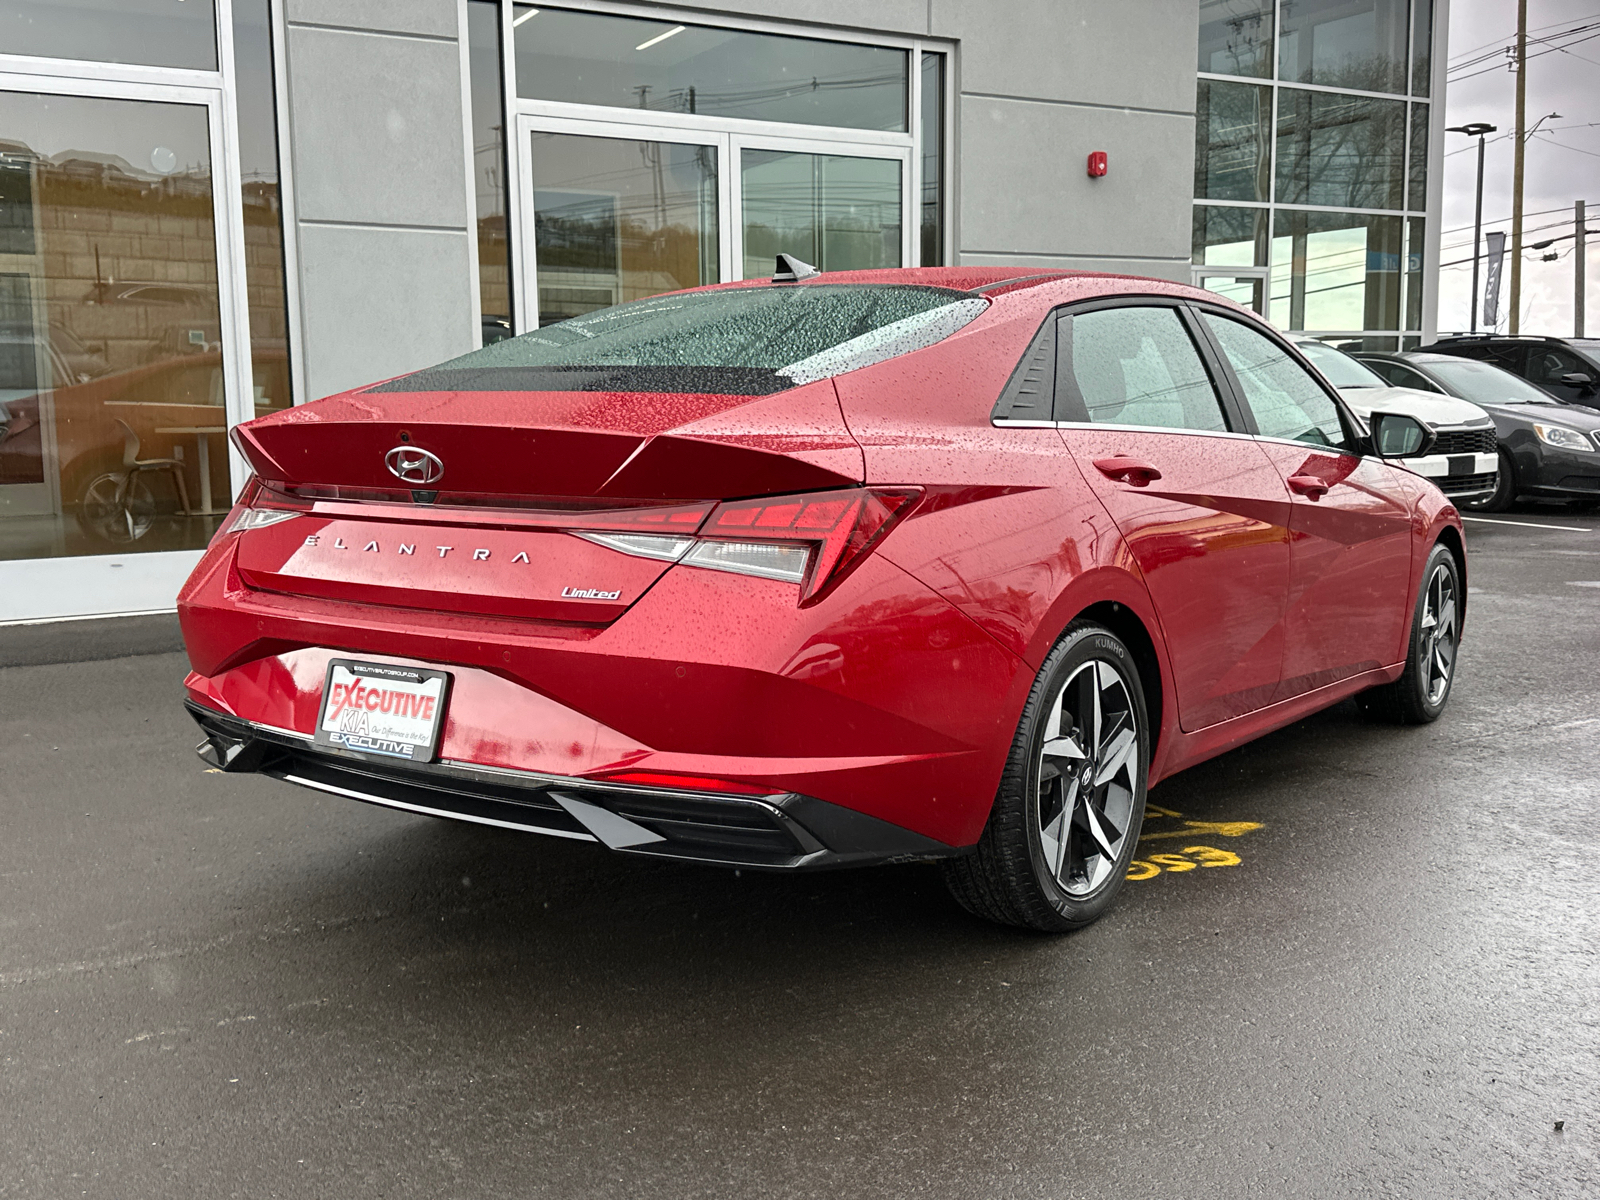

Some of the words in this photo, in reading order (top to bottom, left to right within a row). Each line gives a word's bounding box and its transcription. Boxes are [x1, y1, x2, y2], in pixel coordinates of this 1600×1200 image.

[304, 535, 531, 564] ELANTRA
[561, 586, 622, 600] Limited
[1095, 639, 1124, 659] KUMHO
[329, 677, 436, 721] EXECUTIVE
[340, 708, 369, 736] KIA
[329, 732, 415, 756] EXECUTIVE
